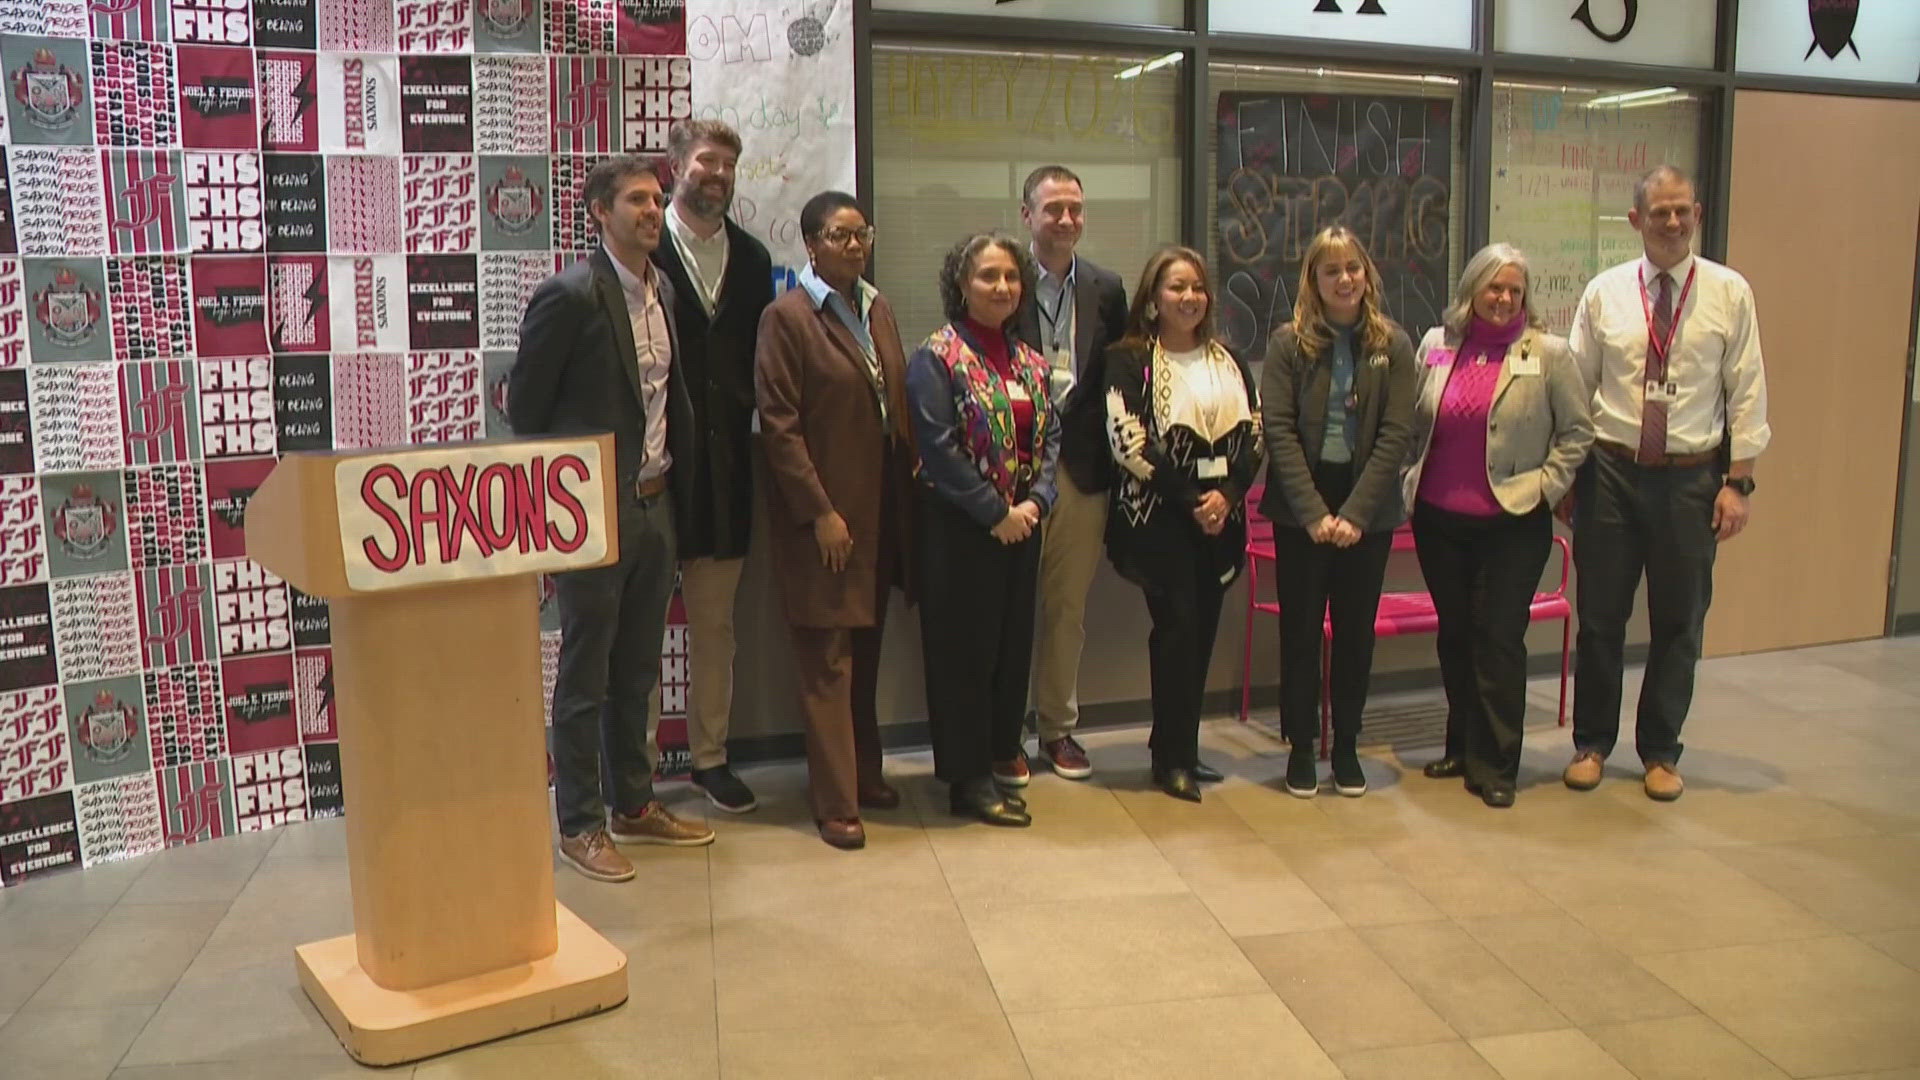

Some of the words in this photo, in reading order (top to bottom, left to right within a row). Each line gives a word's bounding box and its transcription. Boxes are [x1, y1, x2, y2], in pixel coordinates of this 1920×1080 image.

[173, 10, 249, 44] FHS
[625, 57, 691, 87] FHS
[182, 85, 207, 97] JOEL
[220, 86, 254, 98] FERRIS
[403, 84, 470, 96] EXCELLENCE
[887, 51, 1024, 122] HAPPY
[343, 57, 366, 150] FERRIS
[367, 77, 377, 131] SAXONS
[425, 99, 447, 110] FOR
[625, 89, 691, 119] FHS
[410, 113, 466, 125] EVERYONE
[1238, 97, 1431, 176] FINISH
[12, 149, 59, 161] SAXON
[57, 155, 96, 165] PRIDE
[13, 163, 60, 174] SAXON
[58, 169, 97, 178] PRIDE
[186, 153, 259, 185] FHS
[15, 176, 61, 188] SAXON
[60, 182, 98, 192] PRIDE
[16, 190, 63, 201] SAXON
[61, 196, 100, 205] PRIDE
[188, 186, 261, 218] FHS
[18, 204, 64, 214] SAXON
[63, 209, 101, 219] PRIDE
[19, 217, 66, 228] SAXON
[65, 223, 103, 233] PRIDE
[21, 231, 67, 241] SAXON
[66, 237, 104, 246] PRIDE
[190, 218, 263, 251] FHS
[22, 244, 68, 255] SAXON
[410, 282, 475, 293] EXCELLENCE
[196, 296, 220, 307] JOEL
[354, 256, 378, 348] FERRIS
[376, 276, 389, 329] SAXONS
[432, 297, 454, 307] FOR
[417, 311, 472, 322] EVERYONE
[32, 368, 77, 380] SAXON
[75, 370, 113, 381] PRIDE
[201, 358, 269, 392] FHS
[35, 394, 80, 406] SAXON
[78, 396, 115, 407] PRIDE
[203, 390, 272, 424] FHS
[37, 420, 82, 432] SAXON
[80, 423, 118, 433] PRIDE
[205, 422, 275, 456] FHS
[39, 446, 84, 458] SAXON
[82, 449, 120, 459] PRIDE
[211, 498, 234, 510] JOEL
[361, 454, 590, 572] SAXONS
[217, 588, 288, 623] FHS
[0, 632, 24, 646] FOR
[220, 618, 291, 654] FHS
[226, 695, 249, 708] JOEL
[262, 689, 294, 704] FERRIS
[233, 748, 302, 785] FHS
[237, 777, 306, 816] FHS
[27, 841, 51, 856] FOR
[10, 851, 74, 875] EVERYONE
